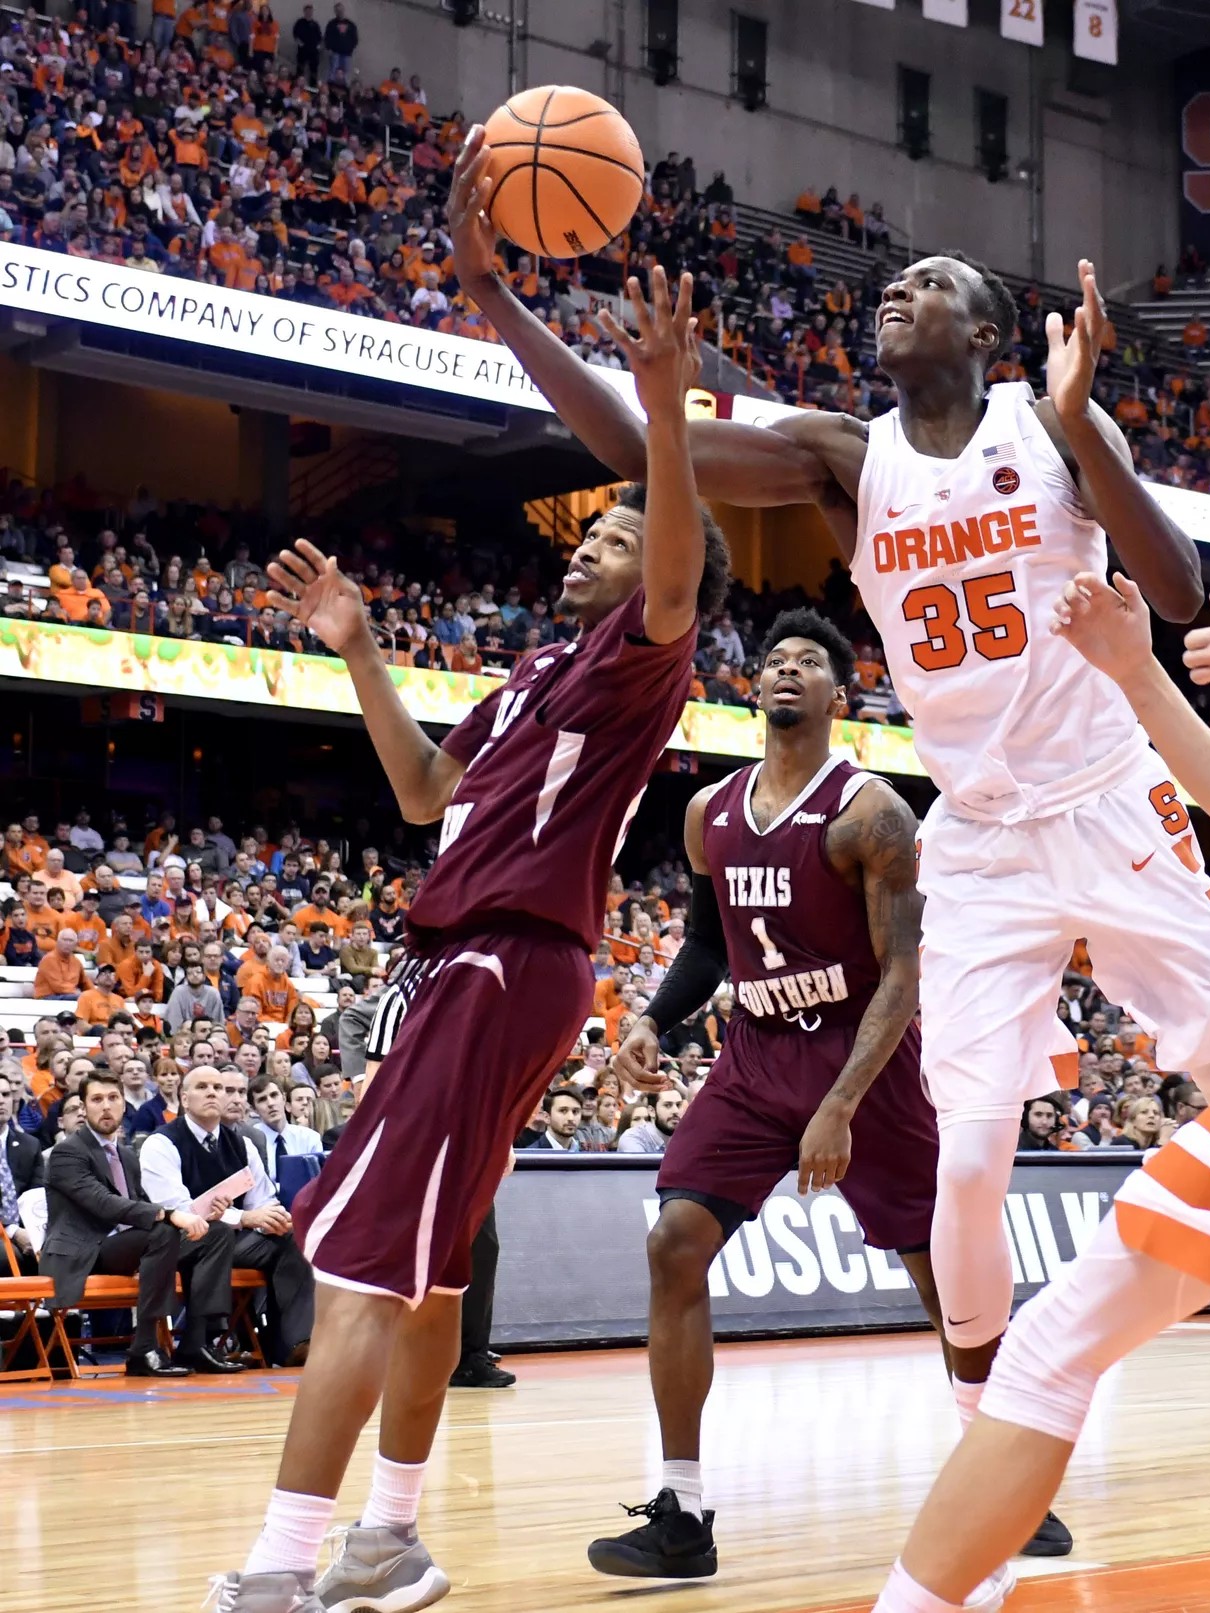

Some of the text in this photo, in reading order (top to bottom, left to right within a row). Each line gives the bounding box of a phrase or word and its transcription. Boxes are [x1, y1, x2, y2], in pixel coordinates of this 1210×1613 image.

[1088, 15, 1102, 38] 8
[2, 262, 90, 302] STICS
[102, 283, 263, 336] COMPANY
[273, 317, 316, 346] OF
[323, 327, 466, 377] SYRACUSE
[873, 504, 1041, 573] ORANGE
[902, 570, 1028, 672] 35
[1148, 780, 1190, 836] S
[725, 866, 792, 907] TEXAS
[751, 917, 787, 971] 1
[738, 963, 849, 1018] SOUTHERN
[643, 1195, 917, 1297] USCL
